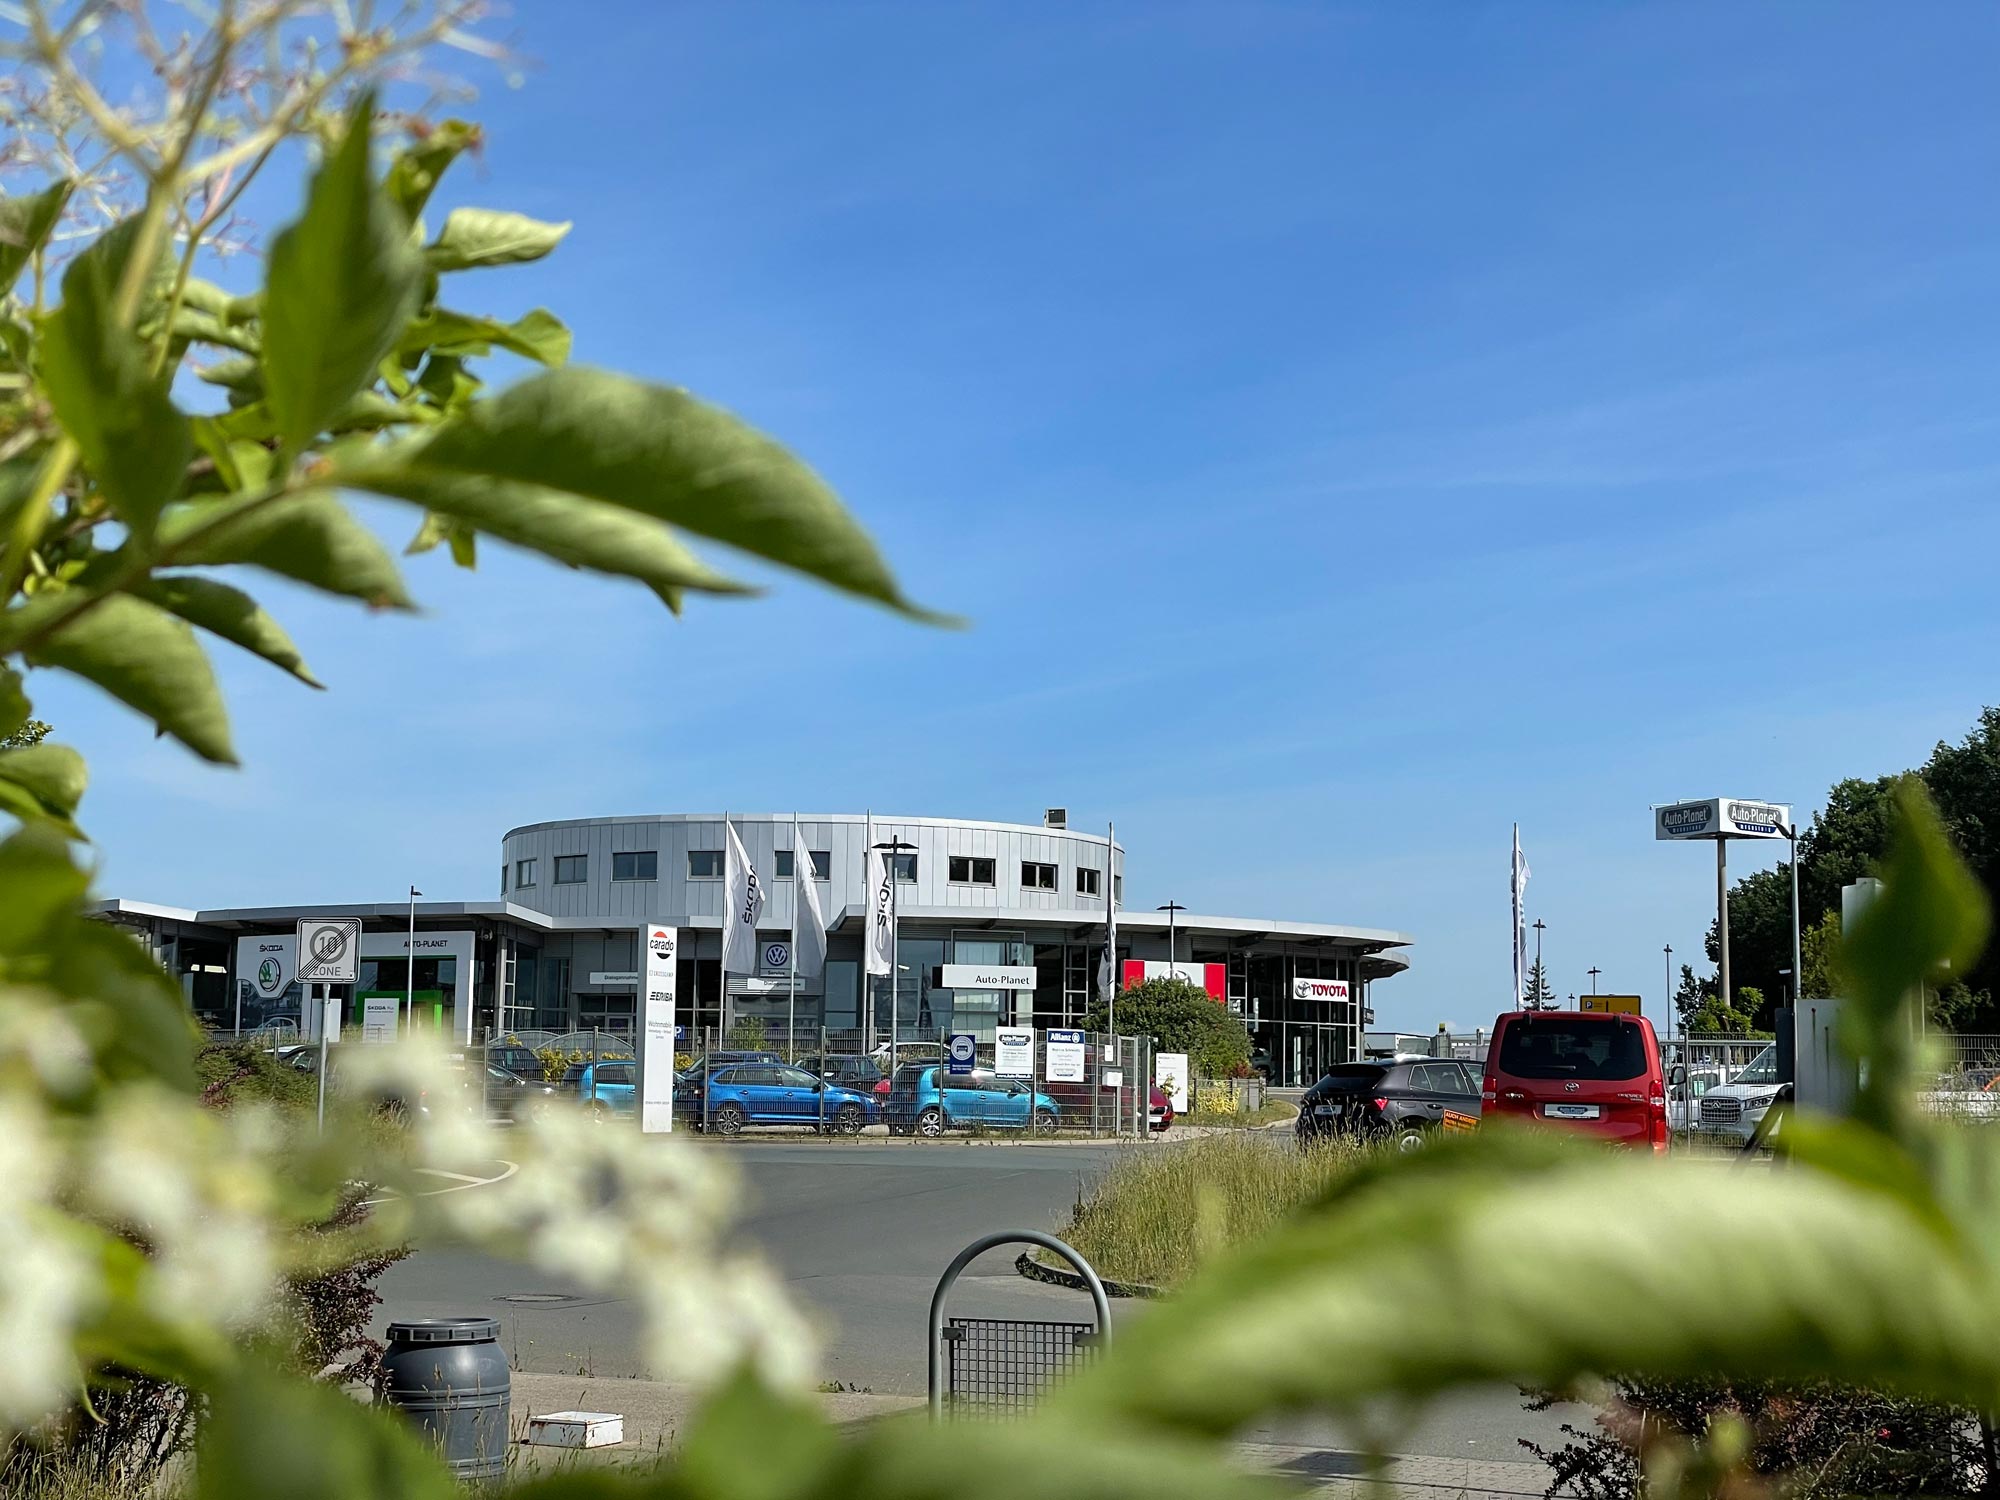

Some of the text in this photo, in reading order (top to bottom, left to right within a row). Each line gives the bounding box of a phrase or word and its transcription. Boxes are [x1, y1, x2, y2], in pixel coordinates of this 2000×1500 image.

[1664, 808, 1707, 826] Auto-Planet
[1731, 806, 1777, 825] Auto-Planet
[259, 944, 283, 952] ŠKODA
[404, 940, 448, 948] ATO-PLANET
[650, 939, 674, 951] carado
[313, 966, 342, 976] ZONE
[975, 975, 1030, 985] Auto-Planet
[1311, 983, 1347, 998] TOYOTA
[1050, 1032, 1072, 1042] Allianz
